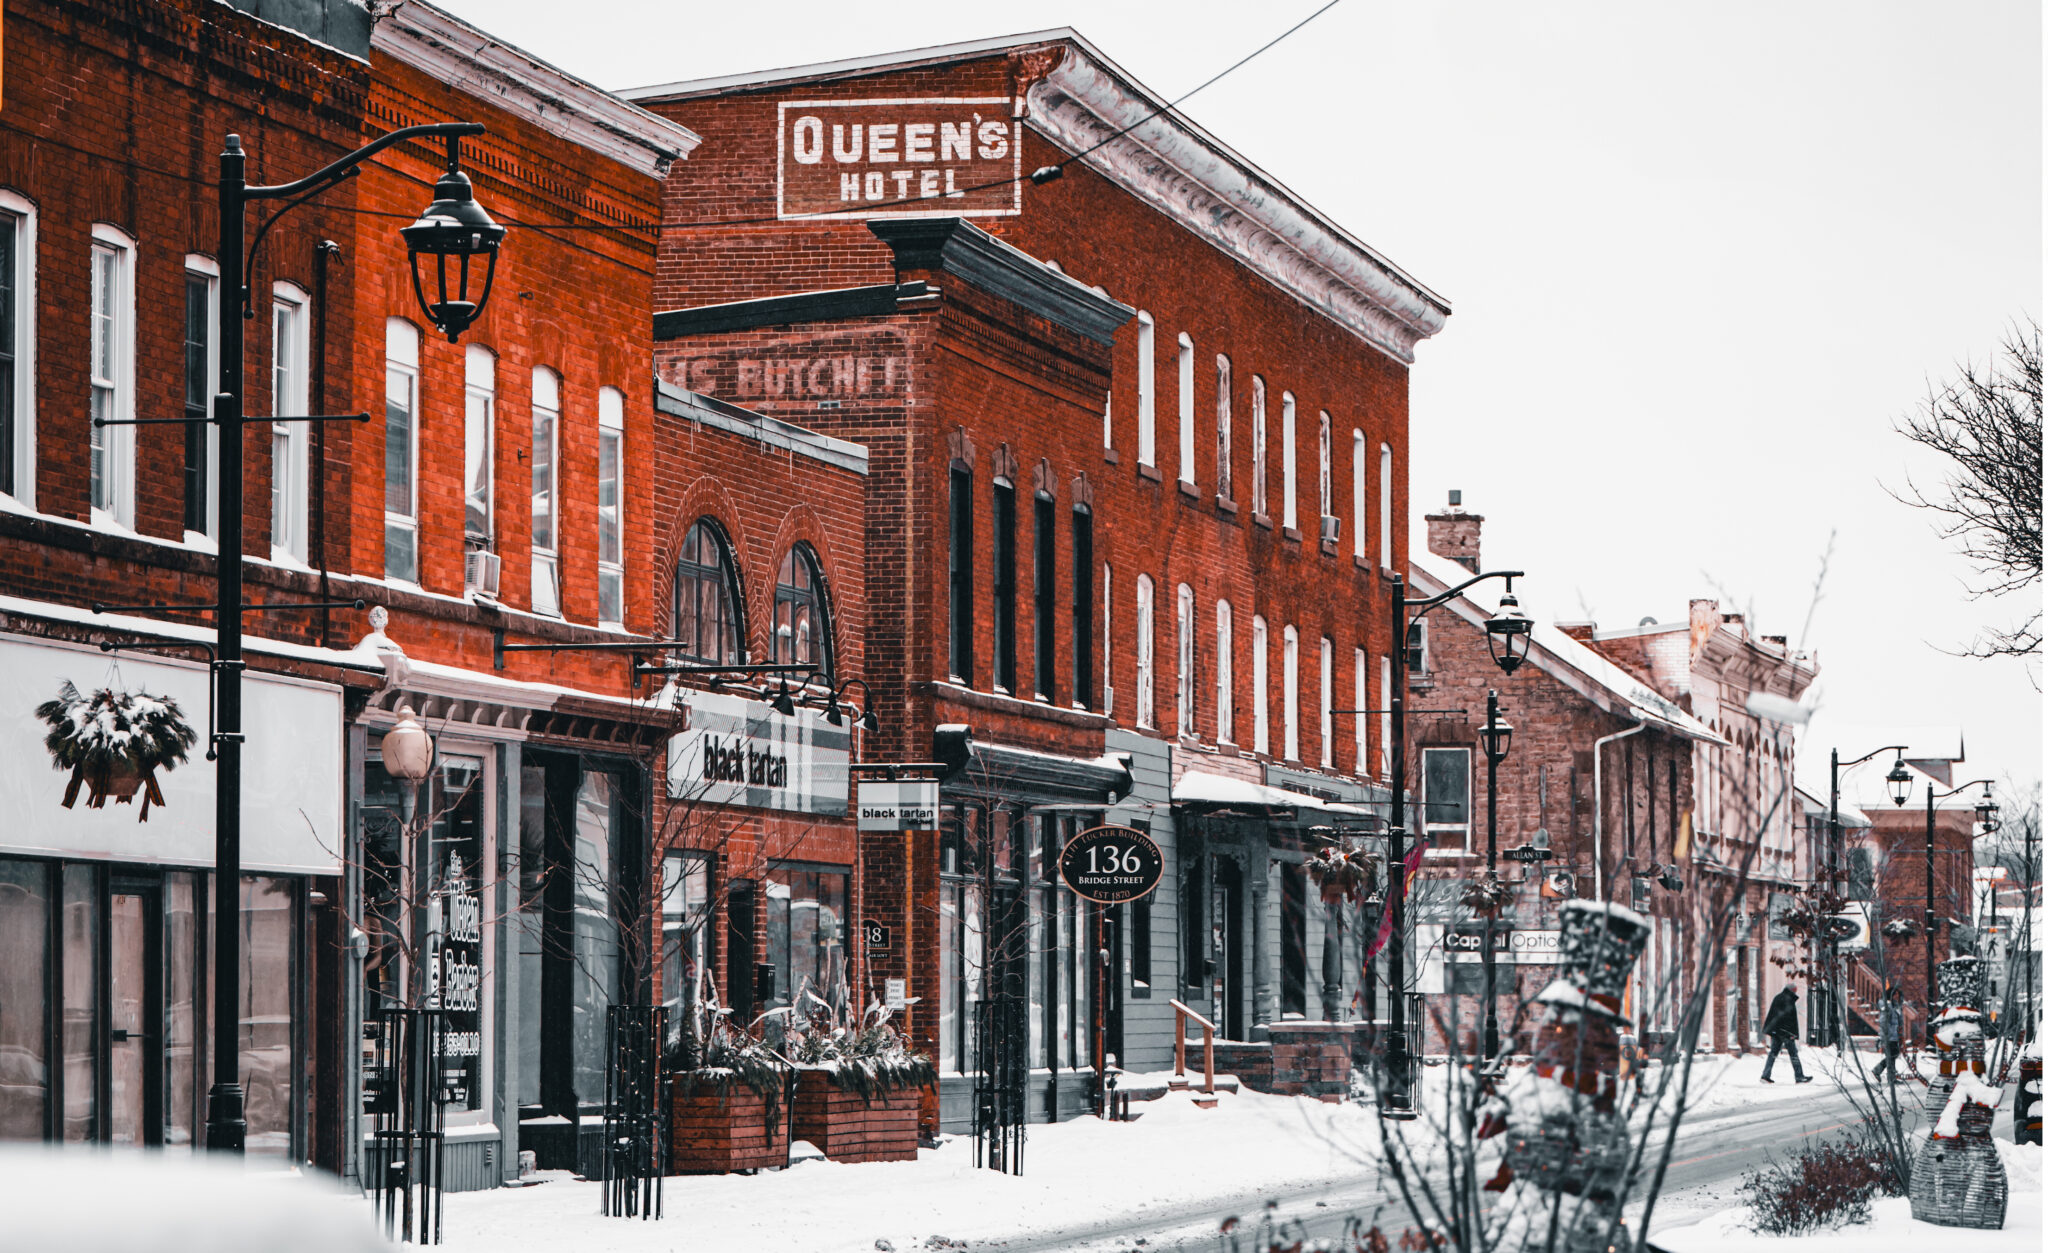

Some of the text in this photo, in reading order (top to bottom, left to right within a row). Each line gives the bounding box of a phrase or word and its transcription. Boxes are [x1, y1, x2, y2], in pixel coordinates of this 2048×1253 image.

[793, 112, 1009, 165] QUEEN'S
[840, 168, 965, 201] HOTEL
[703, 733, 788, 788] black tartan
[862, 808, 934, 818] black tartan
[1118, 829, 1159, 858] BUILDING
[1512, 851, 1534, 859] ALLAN
[1085, 844, 1141, 874] 136
[1078, 875, 1145, 885] BRIDGE STREET
[1111, 889, 1131, 899] 1870
[449, 879, 480, 943] Urban
[1446, 933, 1559, 950] Capal Optic
[444, 949, 479, 1012] Barber
